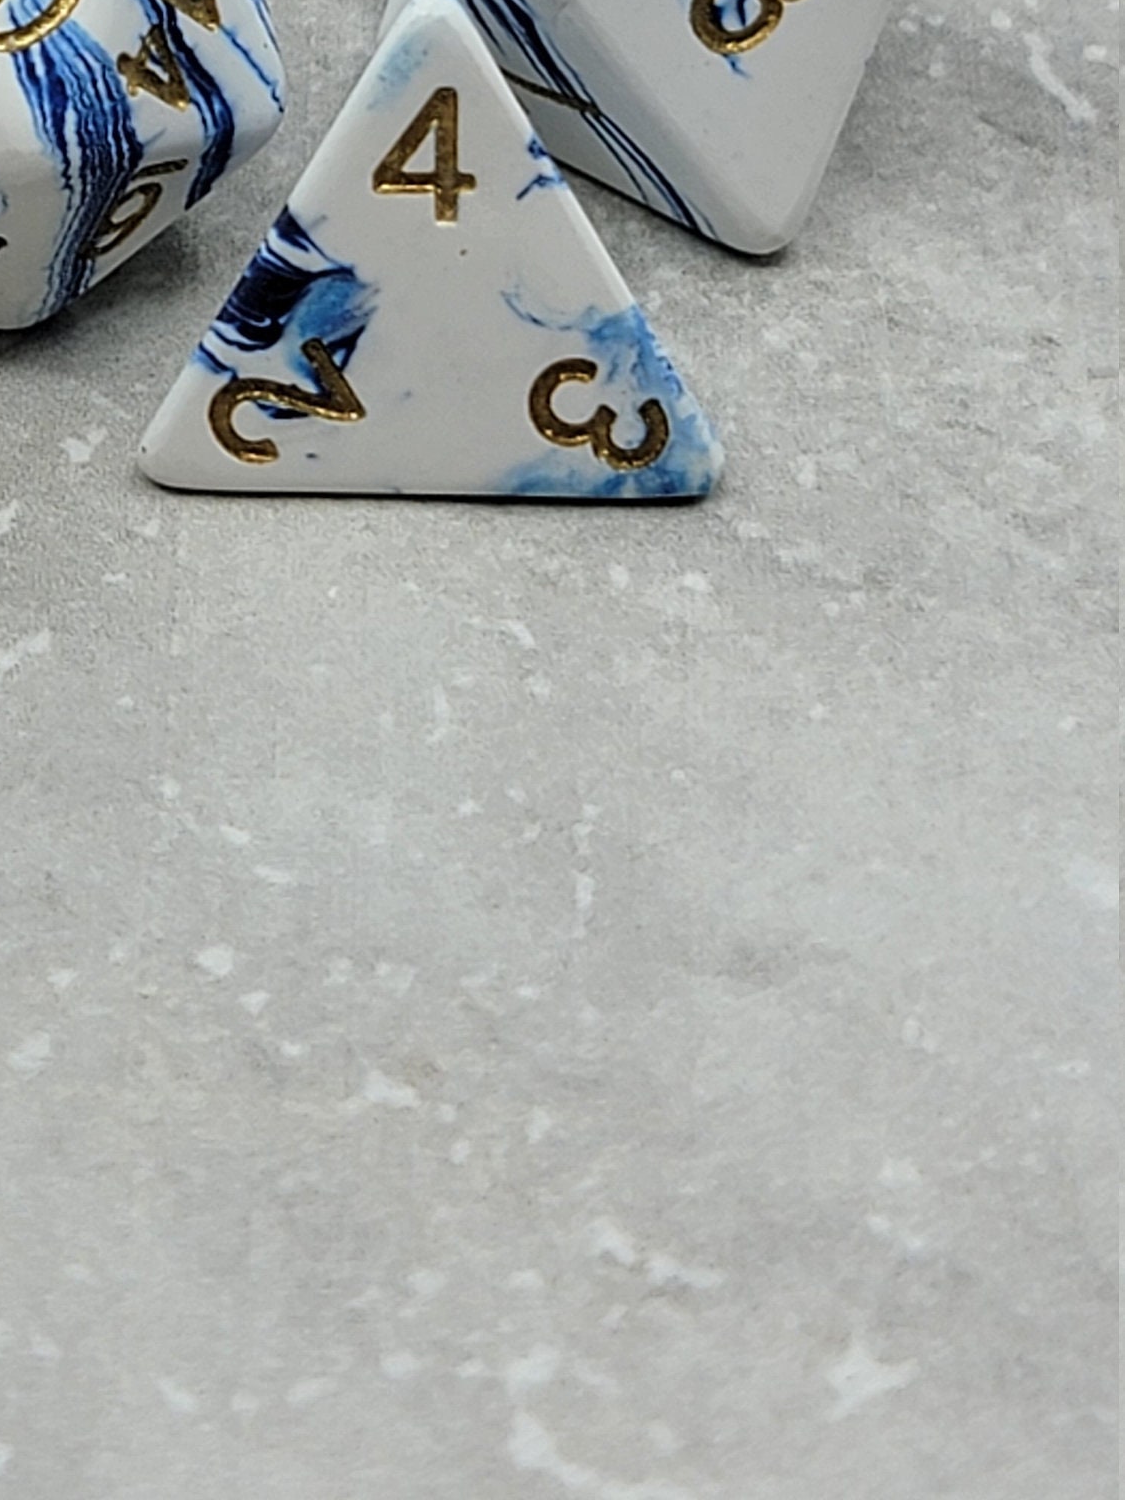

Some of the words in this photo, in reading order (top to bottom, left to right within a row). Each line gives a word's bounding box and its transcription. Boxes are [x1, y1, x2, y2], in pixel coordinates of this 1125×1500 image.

[372, 86, 477, 227] 4
[207, 338, 367, 464] 2
[527, 357, 671, 472] 3
